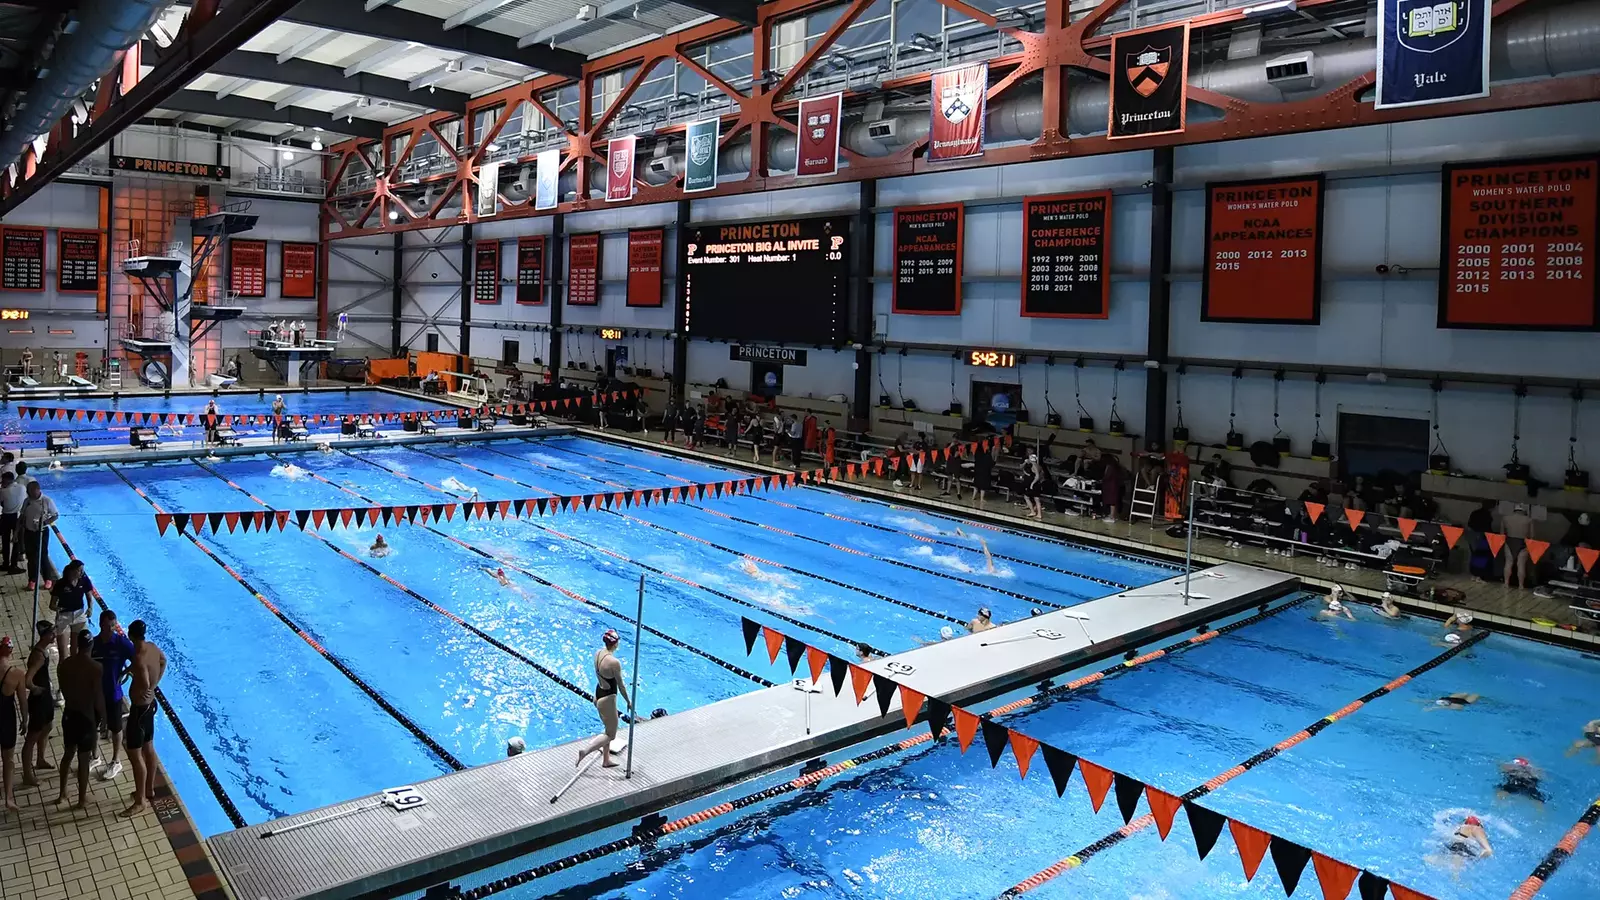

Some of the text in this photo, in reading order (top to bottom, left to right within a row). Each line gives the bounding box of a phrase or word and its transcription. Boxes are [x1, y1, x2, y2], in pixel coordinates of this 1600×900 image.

[1414, 71, 1447, 88] Yale
[1121, 110, 1171, 126] Princeton
[934, 137, 977, 150] Pennsylvania
[135, 159, 208, 175] PRINCETON
[804, 156, 828, 167] Harvard
[1457, 167, 1590, 187] PRINCETON
[1216, 186, 1312, 202] PRINCETON
[1473, 184, 1571, 196] WOMEN'S WATER POLO
[1031, 200, 1103, 215] PRINCETON
[1228, 202, 1256, 210] WOMEN'S
[1470, 197, 1575, 212] SOUTHERN
[899, 212, 956, 223] PRINCETON
[1244, 218, 1280, 229] NCAA
[1479, 211, 1563, 225] DIVISION
[720, 223, 800, 240] PRINCETON
[1031, 227, 1101, 238] CONFERENCE
[1213, 228, 1313, 241] APPEARANCES
[1464, 225, 1579, 240] CHAMPIONS
[916, 235, 938, 243] NCAA
[1034, 237, 1097, 247] CHAMPIONS
[687, 236, 844, 256] P PRINCETON BIG AL INVITE P
[898, 243, 956, 252] APPEARANCES
[1458, 243, 1583, 254] 2000 2001 2004
[687, 256, 703, 264] Event
[704, 255, 727, 264] Number:
[729, 255, 740, 263] 301
[748, 254, 763, 263] Heat
[763, 254, 790, 263] Number:
[1216, 249, 1307, 259] 2000 2012 2013
[1215, 262, 1240, 270] 2015
[1457, 256, 1583, 267] 2005 2006 2008
[1457, 270, 1582, 280] 2012 2013 2014
[1456, 284, 1489, 293] 2015
[739, 346, 796, 360] PRINCETON
[972, 351, 1014, 367] 5:42:11
